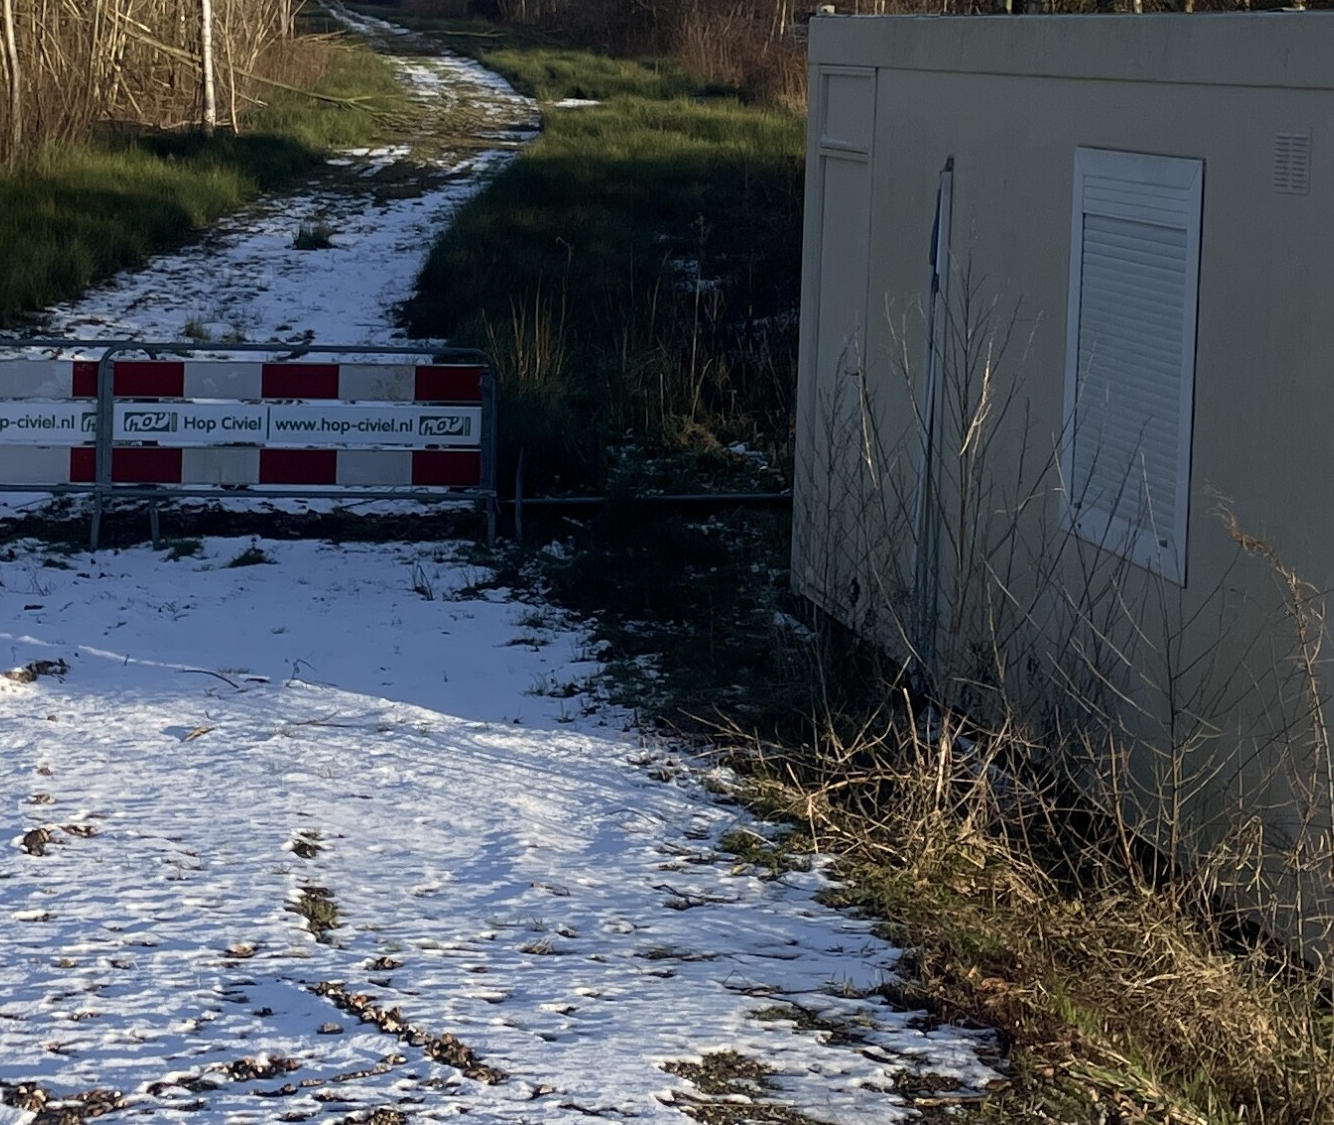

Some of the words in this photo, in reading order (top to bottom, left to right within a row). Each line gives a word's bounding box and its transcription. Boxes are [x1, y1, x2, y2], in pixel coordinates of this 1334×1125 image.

[183, 416, 217, 433] Hop
[221, 416, 262, 431] Civiel
[275, 417, 413, 435] www.hop-civiel.nl
